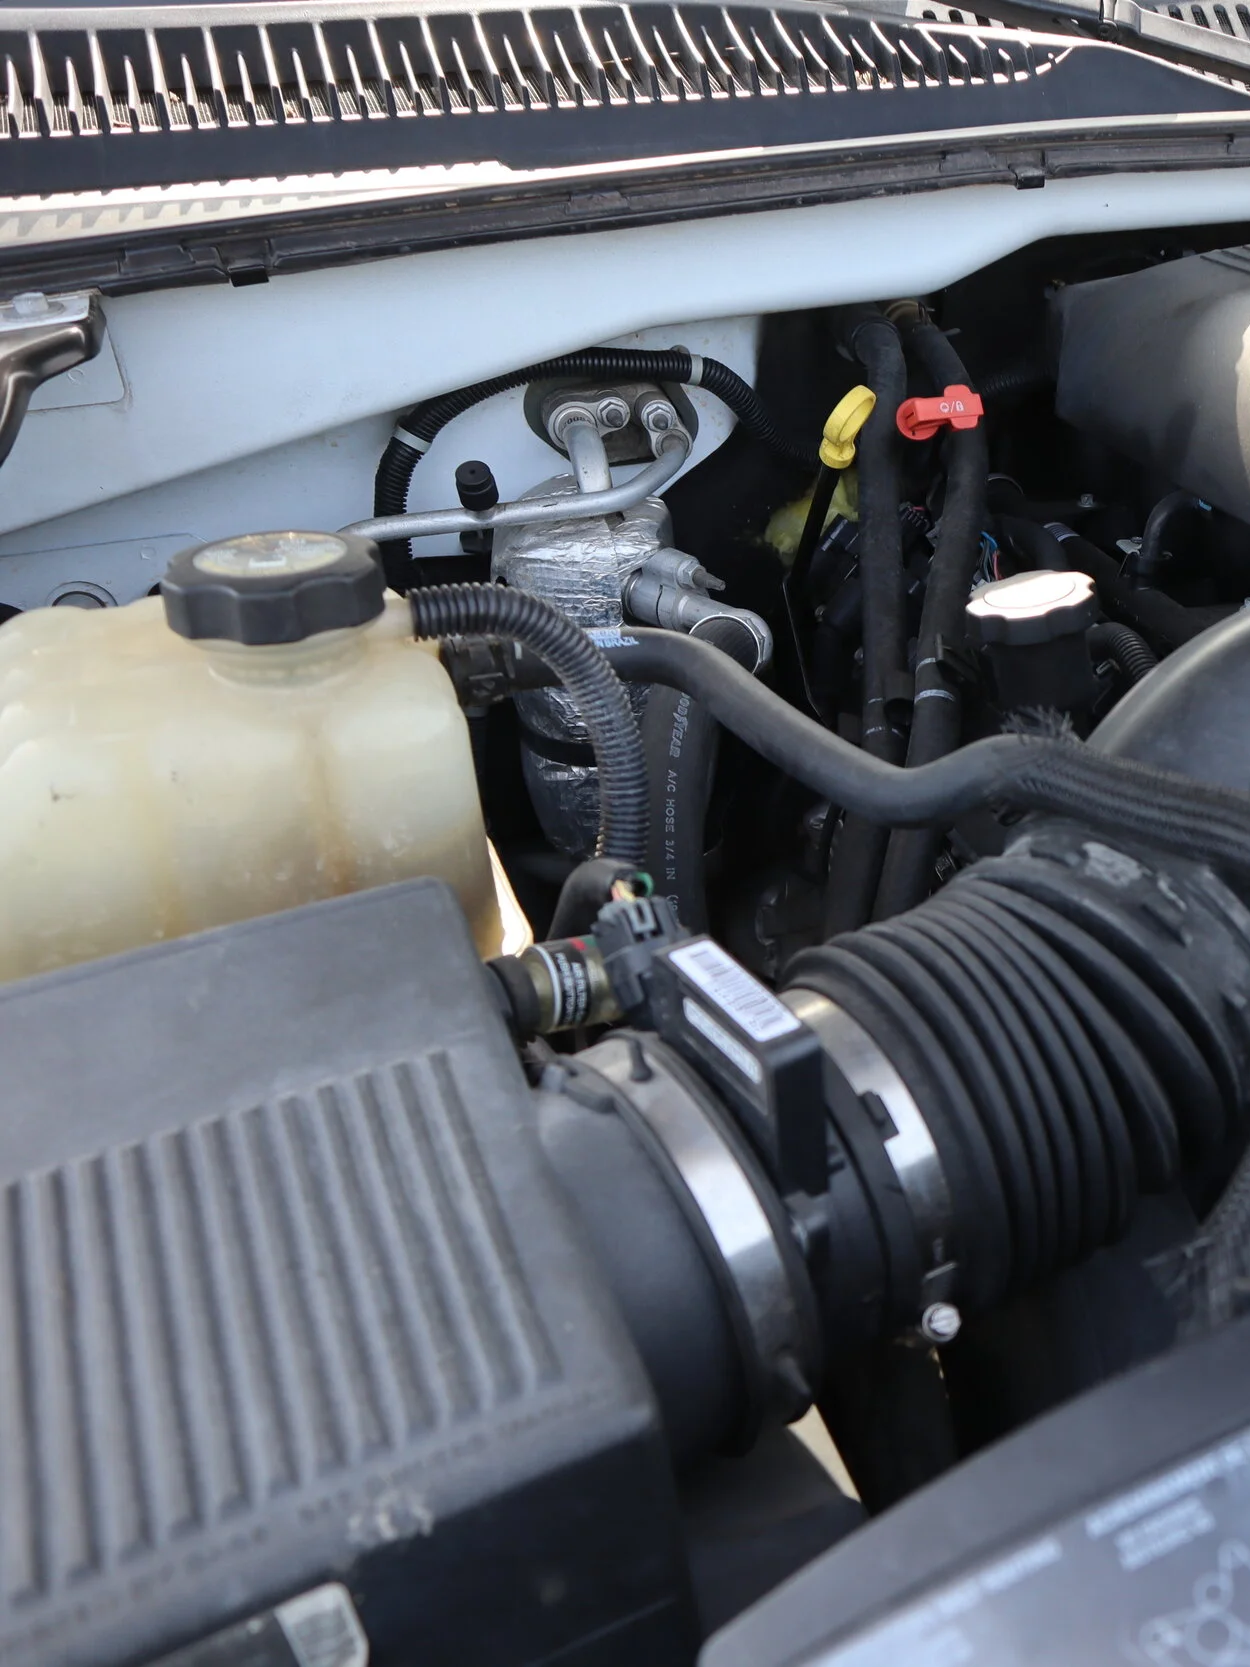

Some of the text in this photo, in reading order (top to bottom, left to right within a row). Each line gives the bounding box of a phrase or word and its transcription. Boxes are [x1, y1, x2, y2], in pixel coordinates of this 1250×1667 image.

[666, 769, 679, 793] A/C
[665, 799, 675, 833] HOSE
[665, 840, 675, 860] 3/4
[666, 867, 676, 880] IN
